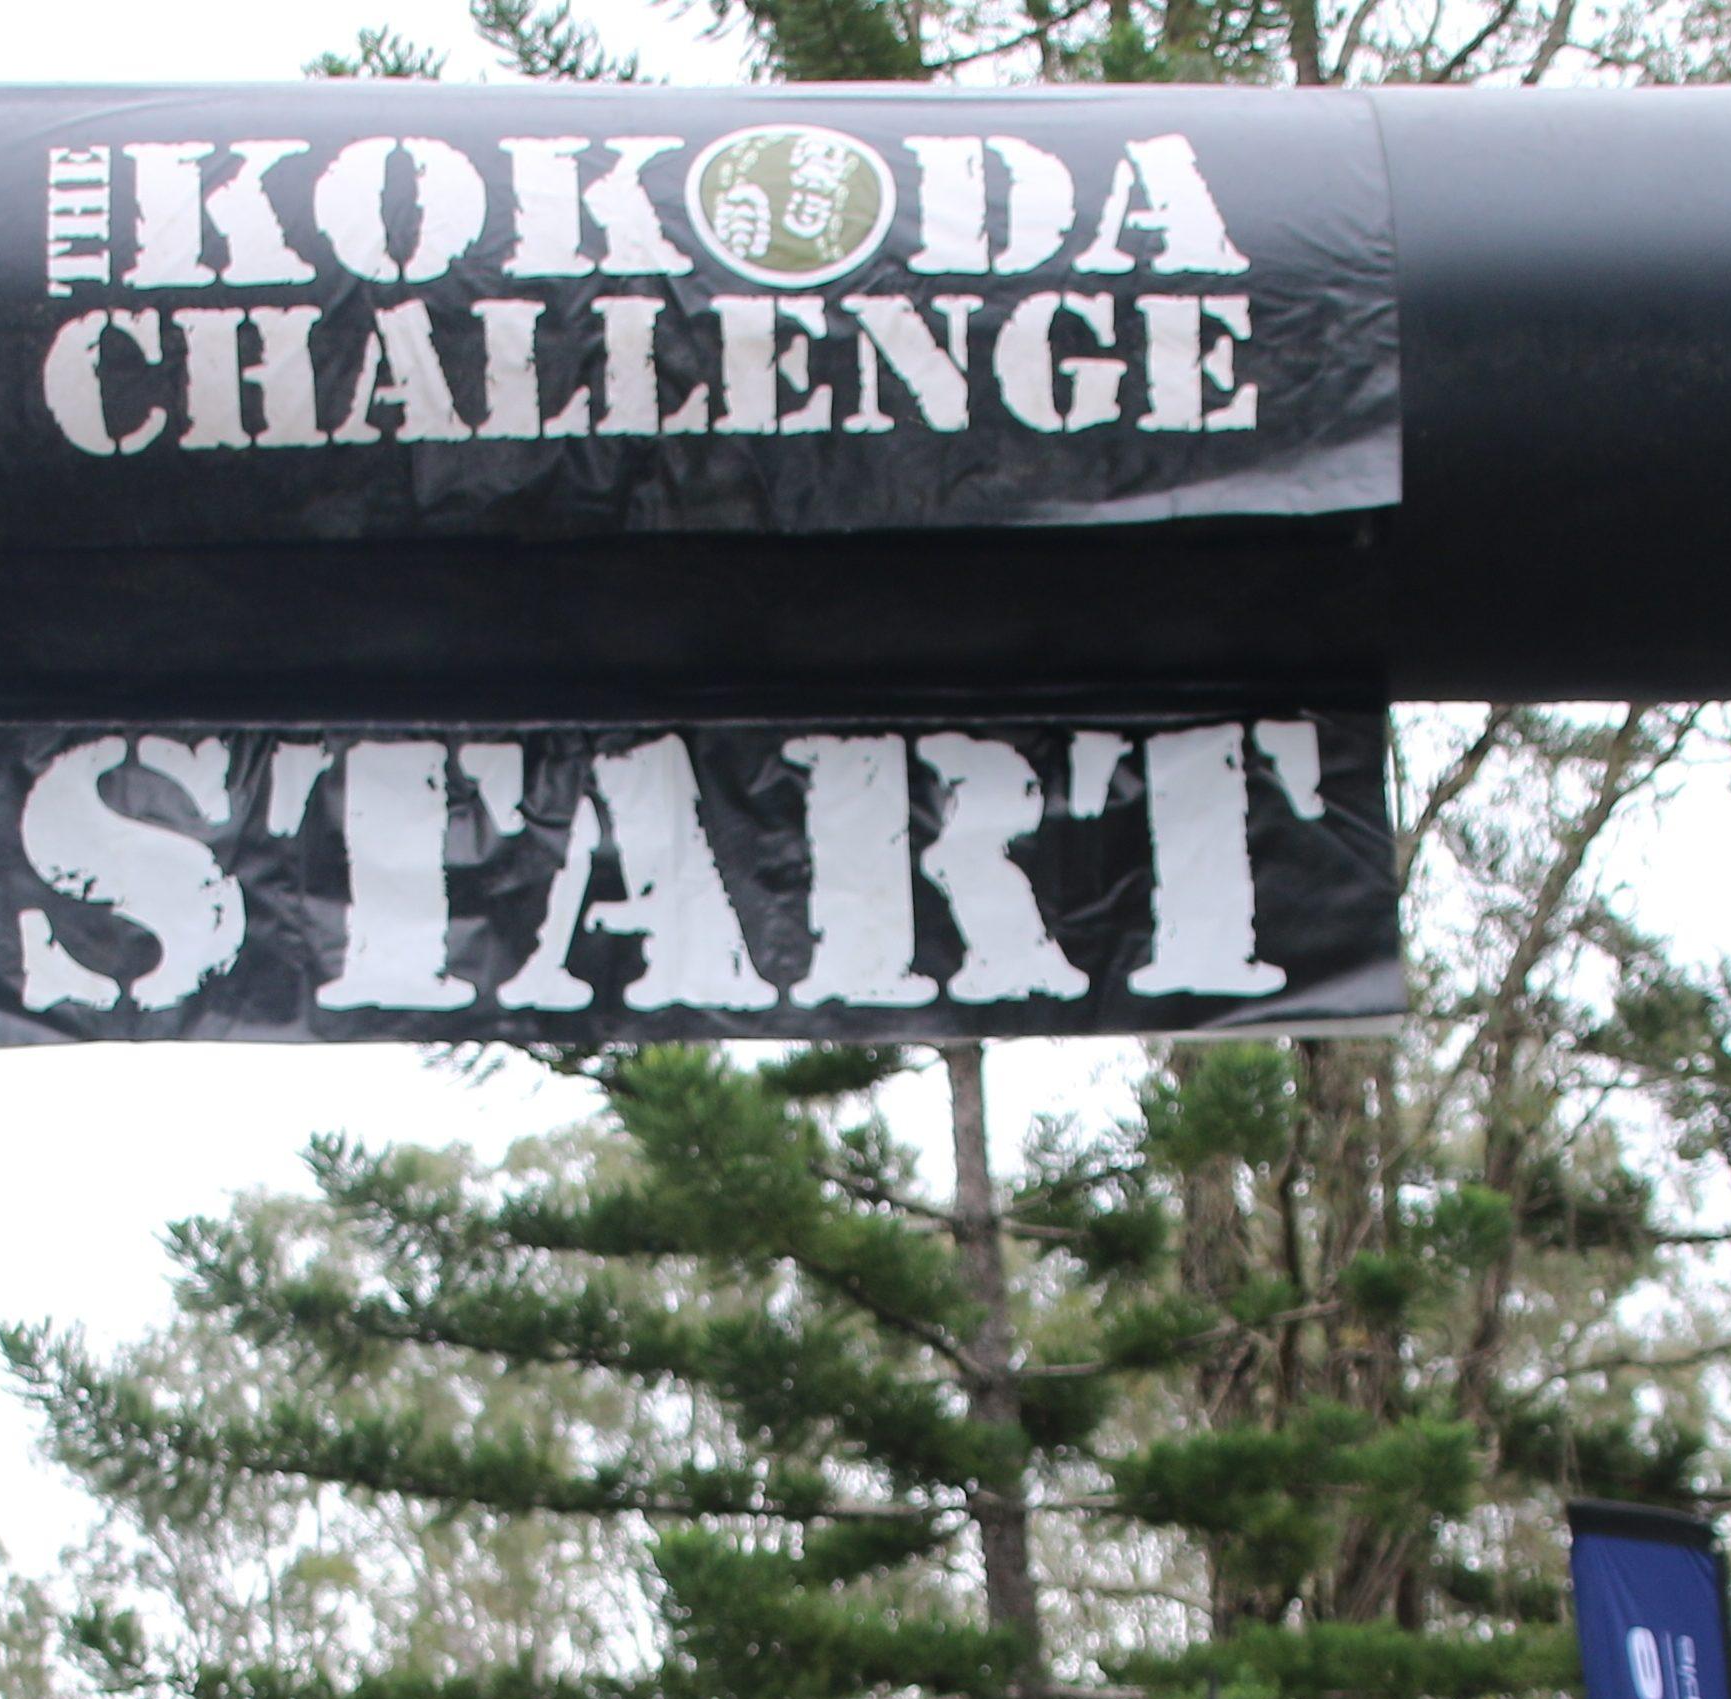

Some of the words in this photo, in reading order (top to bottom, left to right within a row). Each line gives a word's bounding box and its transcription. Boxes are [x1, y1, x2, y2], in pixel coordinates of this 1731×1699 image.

[47, 145, 109, 297] THE
[43, 291, 1258, 456] CHALLENGE
[19, 719, 1326, 1012] START
